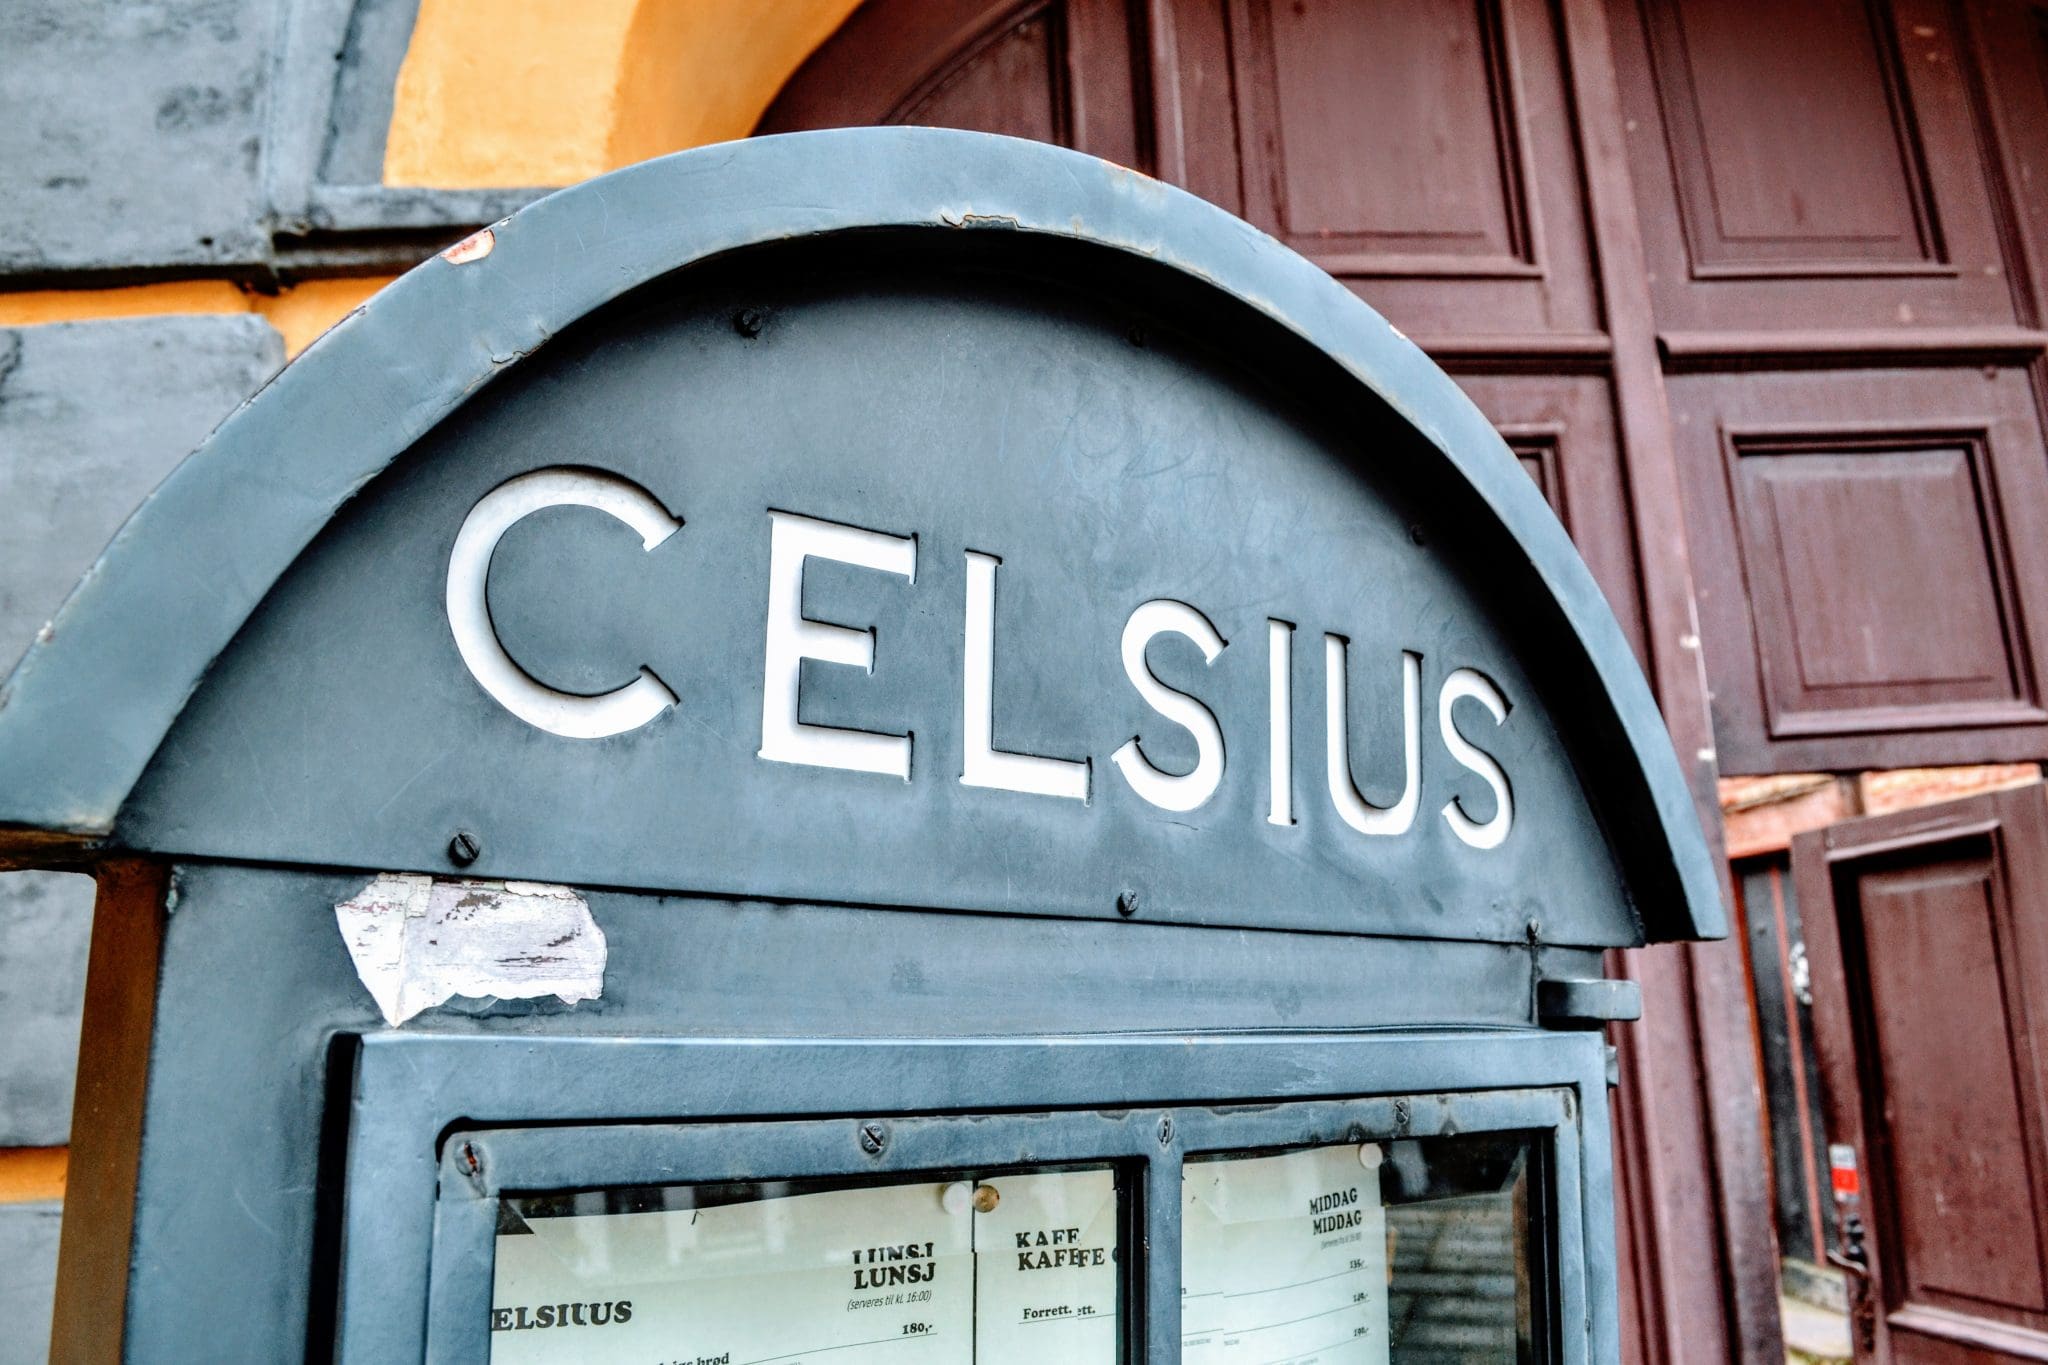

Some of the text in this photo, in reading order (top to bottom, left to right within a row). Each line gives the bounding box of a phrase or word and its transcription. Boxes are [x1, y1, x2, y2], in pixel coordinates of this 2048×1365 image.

[445, 465, 1515, 851] CELSIUS
[1309, 1187, 1358, 1215] MIDDAG
[1313, 1210, 1362, 1235] MIDDAG
[853, 1262, 936, 1290] LUNSJ
[885, 1294, 894, 1305] til
[1023, 1305, 1072, 1319] Forrett.
